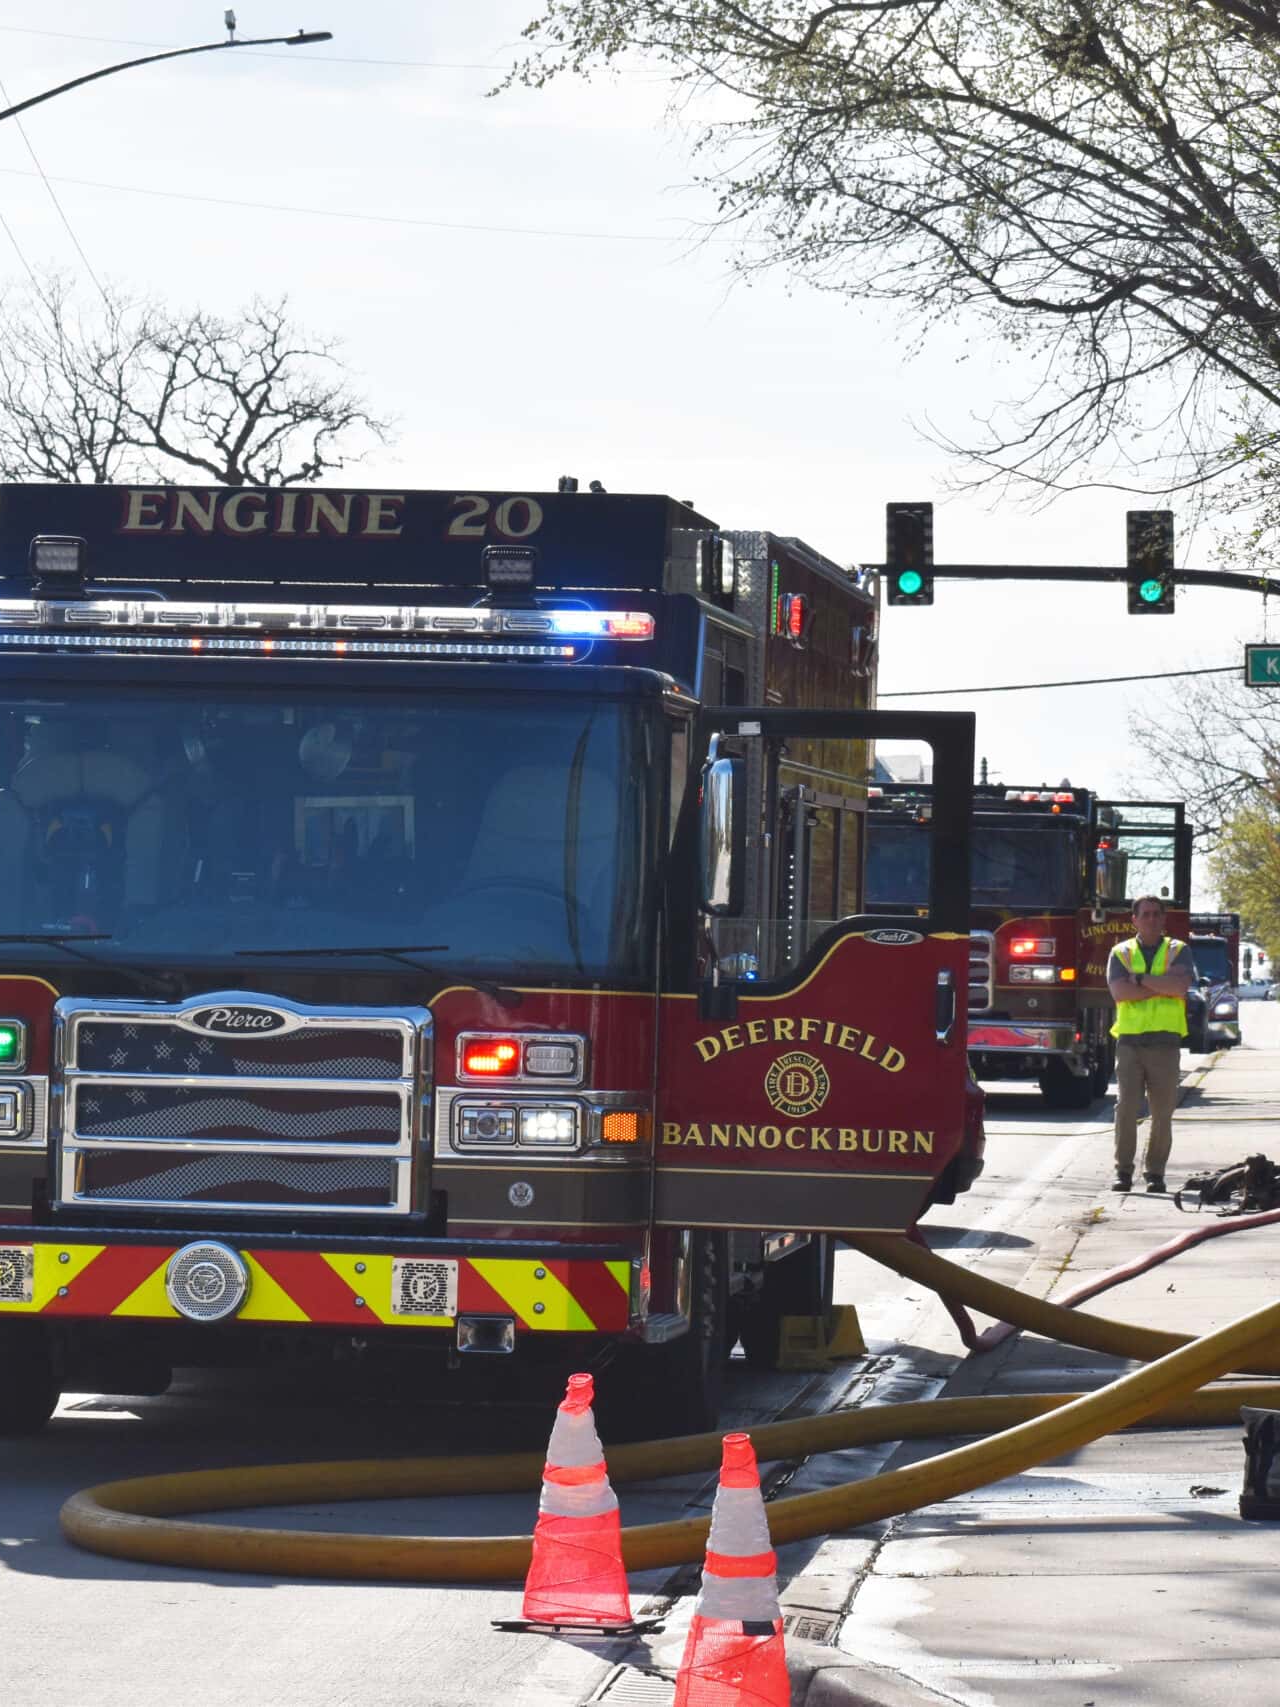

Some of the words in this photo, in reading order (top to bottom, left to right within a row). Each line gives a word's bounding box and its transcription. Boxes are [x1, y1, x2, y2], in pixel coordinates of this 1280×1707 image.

[122, 489, 406, 538] ENGINE
[445, 494, 544, 539] 20
[205, 1008, 274, 1031] Pierce
[694, 1017, 906, 1073] DEERFIELD
[783, 1055, 813, 1066] RESCUE
[768, 1072, 778, 1096] FIRE
[816, 1074, 826, 1096] EMS
[661, 1121, 936, 1154] BANNOCKBURN
